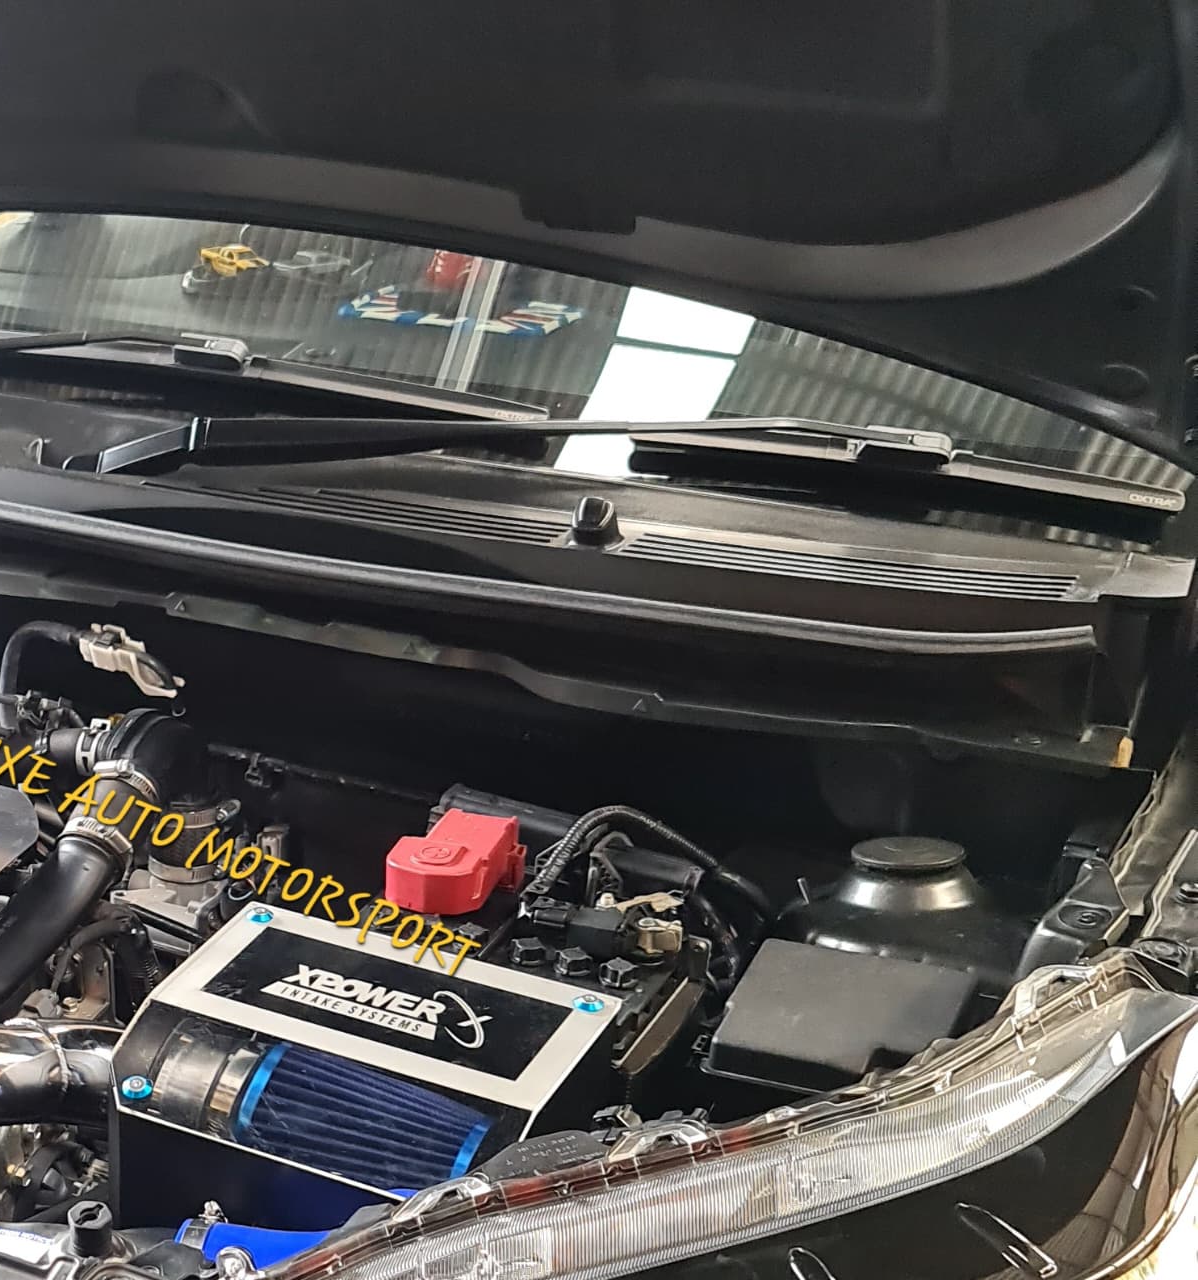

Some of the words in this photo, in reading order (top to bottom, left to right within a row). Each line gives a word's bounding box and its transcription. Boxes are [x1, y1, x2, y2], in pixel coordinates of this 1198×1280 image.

[280, 986, 339, 1010] INTAKE
[348, 1006, 423, 1033] SYSTEMS
[282, 963, 447, 1024] XPOWER
